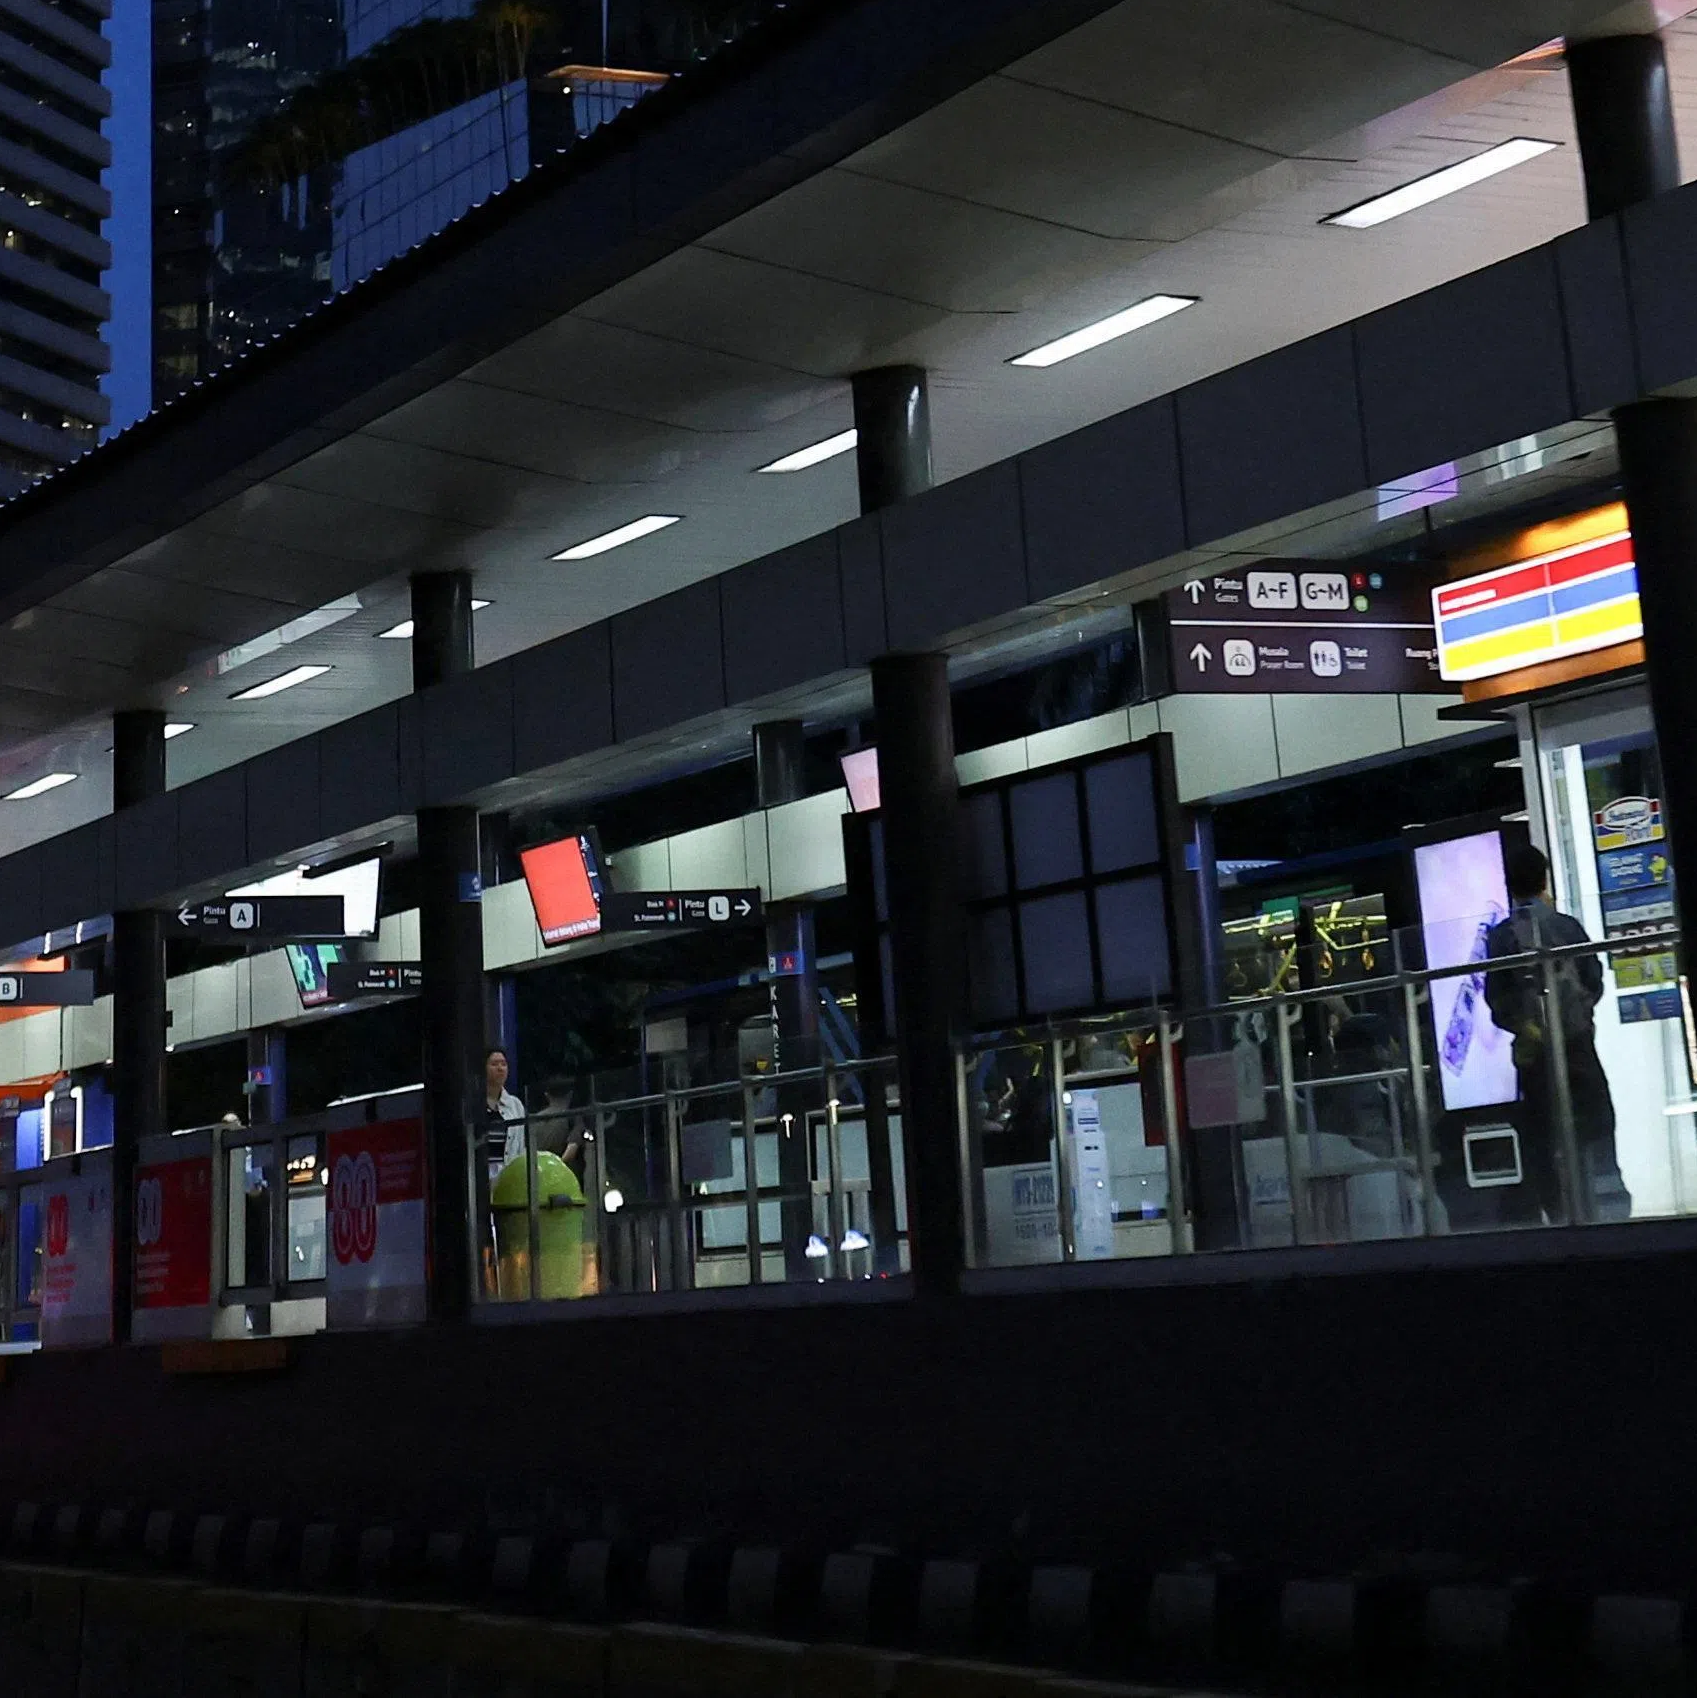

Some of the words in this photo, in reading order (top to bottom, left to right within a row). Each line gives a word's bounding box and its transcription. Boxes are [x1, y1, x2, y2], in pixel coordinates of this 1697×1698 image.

[715, 902, 723, 914] L
[236, 909, 246, 922] A
[2, 983, 10, 995] B
